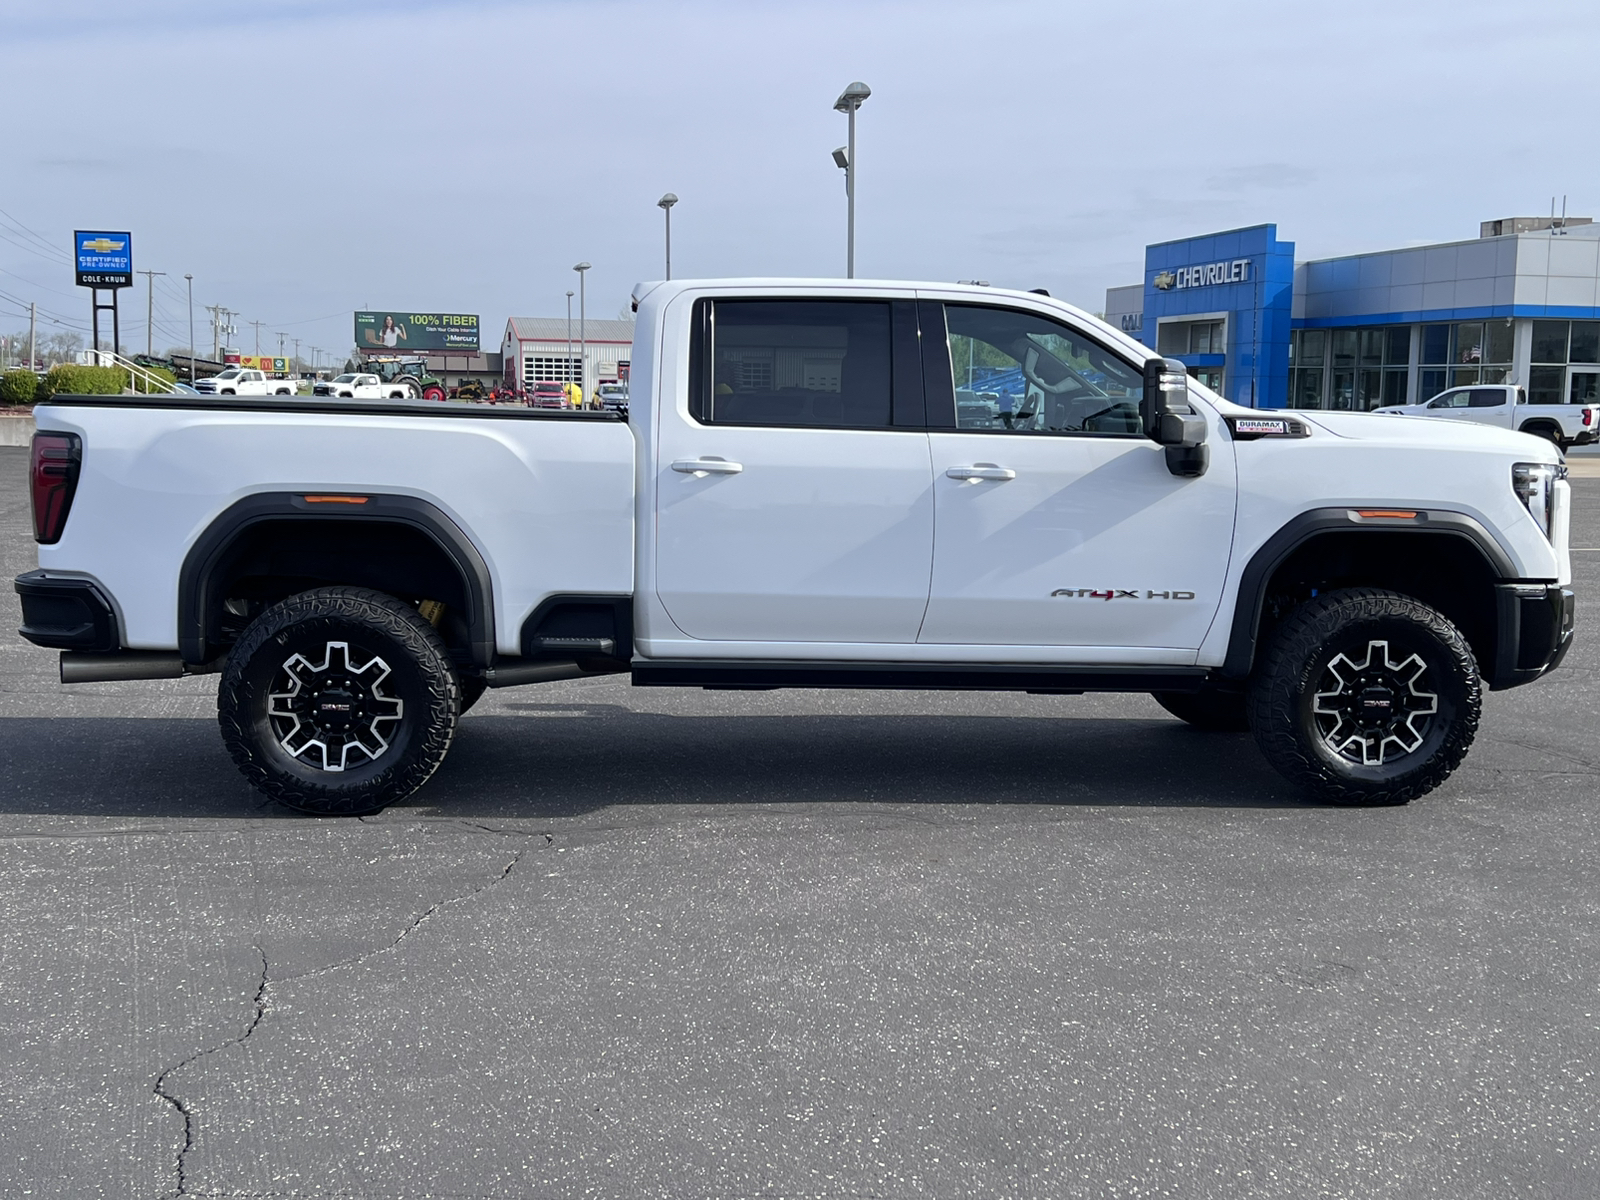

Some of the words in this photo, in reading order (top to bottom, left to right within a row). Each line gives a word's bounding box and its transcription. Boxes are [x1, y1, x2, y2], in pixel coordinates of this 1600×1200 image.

[1176, 259, 1249, 289] CHEVROLET
[409, 315, 440, 325] 100%
[443, 315, 477, 327] FIBER
[450, 335, 478, 343] Mercury
[1050, 588, 1140, 601] AT4X
[1147, 590, 1196, 600] HD
